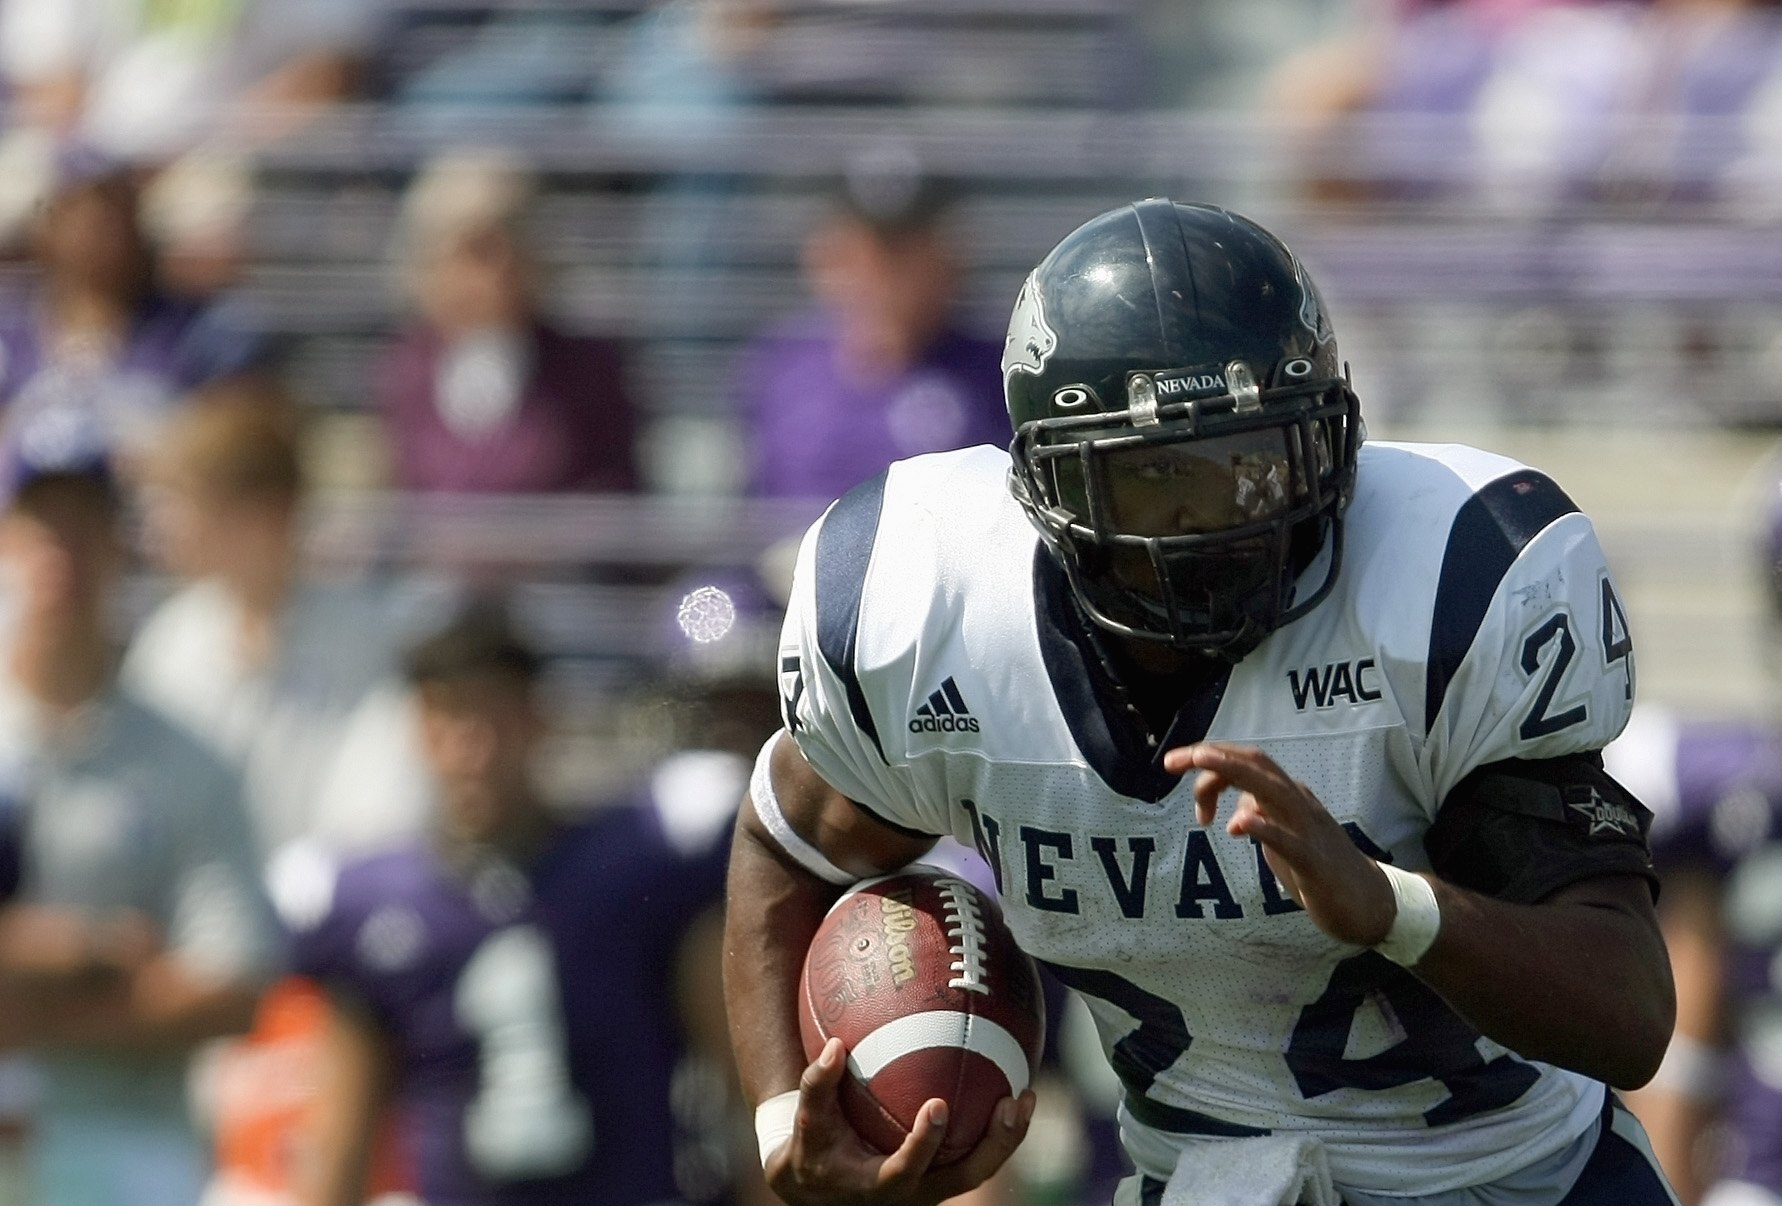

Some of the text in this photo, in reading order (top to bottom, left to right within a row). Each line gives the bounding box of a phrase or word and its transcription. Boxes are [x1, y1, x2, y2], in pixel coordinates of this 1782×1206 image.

[1155, 374, 1225, 394] NEVADA
[1286, 659, 1382, 710] WAC
[1520, 577, 1632, 741] 24
[908, 713, 980, 733] adidas
[960, 800, 1393, 920] NEVA
[880, 887, 917, 988] Wilson
[456, 925, 595, 1180] 1
